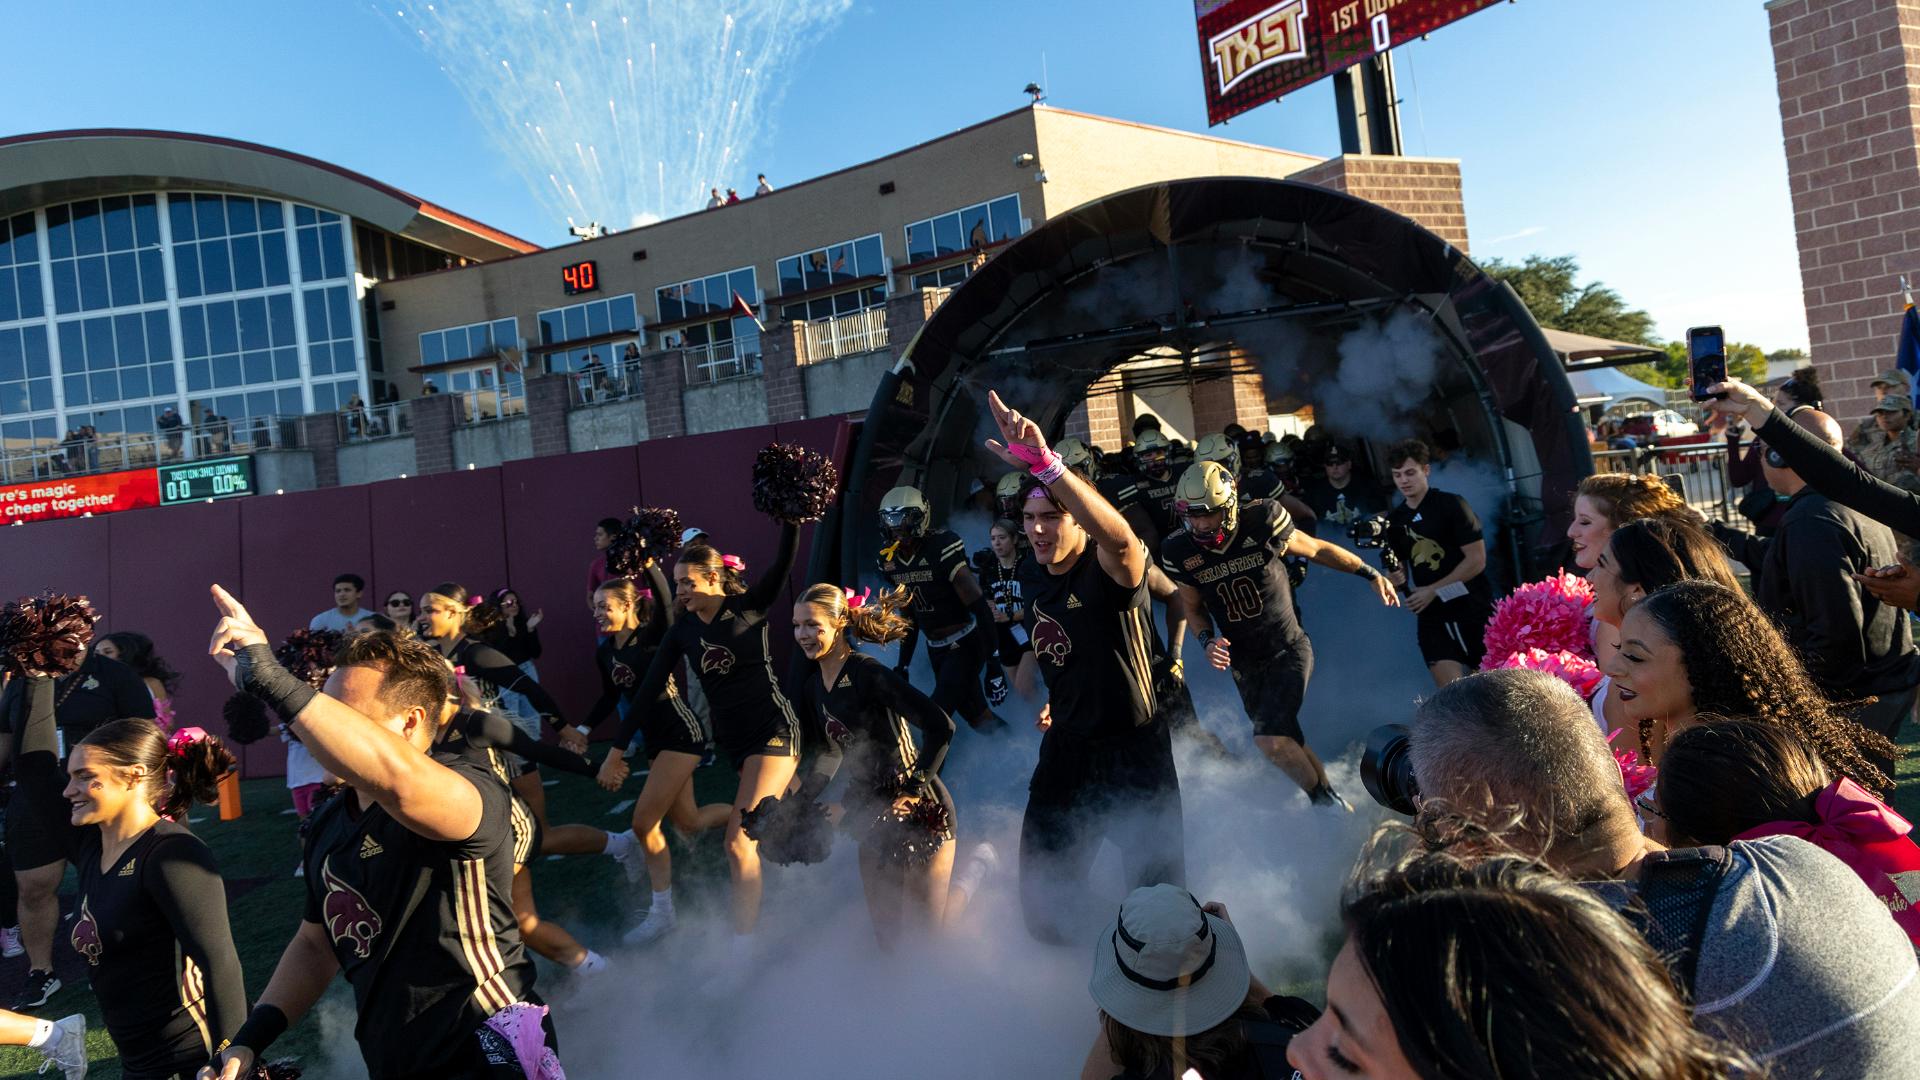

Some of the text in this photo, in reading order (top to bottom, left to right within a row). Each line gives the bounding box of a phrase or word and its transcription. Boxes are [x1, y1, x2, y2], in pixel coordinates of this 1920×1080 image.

[1331, 0, 1360, 34] 1ST
[1371, 13, 1391, 52] 0
[1212, 0, 1304, 88] TXST
[564, 262, 593, 289] 40
[215, 464, 239, 475] DOWN
[5, 494, 115, 516] cheer together
[31, 483, 76, 498] magic
[1193, 563, 1229, 584] TEXAS
[1228, 552, 1265, 574] STATE
[1216, 576, 1263, 622] 10
